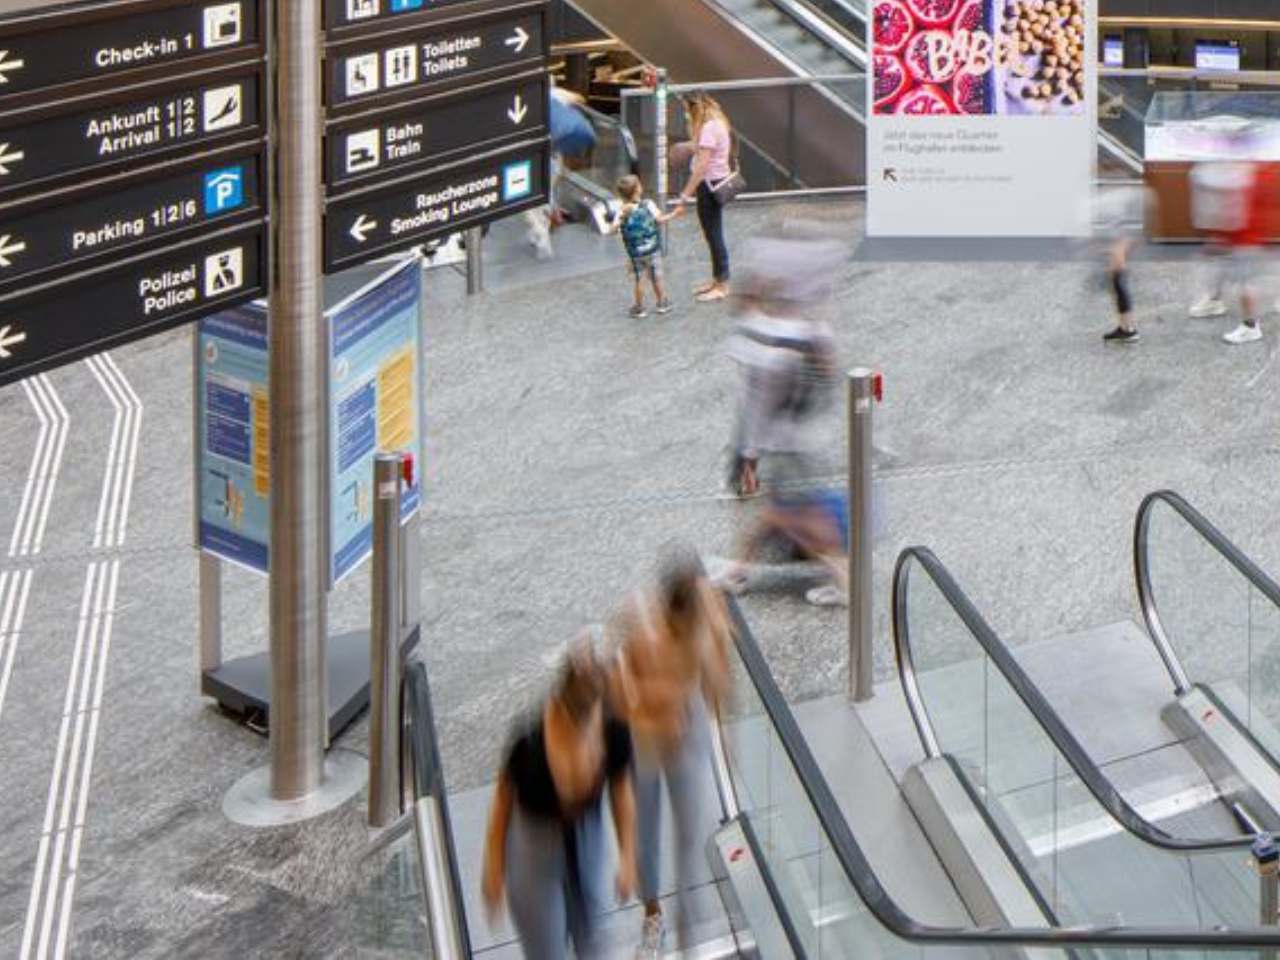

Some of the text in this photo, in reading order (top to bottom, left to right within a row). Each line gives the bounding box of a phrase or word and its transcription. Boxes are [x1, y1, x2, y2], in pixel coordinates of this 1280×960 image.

[95, 34, 193, 68] Check-in 1
[422, 37, 481, 58] Toiletten
[422, 56, 468, 77] Toilets
[86, 106, 160, 139] Ankunft
[386, 123, 424, 144] Bahn
[99, 125, 160, 155] Arrival
[386, 140, 422, 161] Train
[416, 174, 498, 208] Raucherzone
[391, 192, 499, 235] Smoking Lounge
[72, 215, 144, 250] Parking
[139, 265, 196, 297] Polizei
[144, 287, 196, 316] Police
